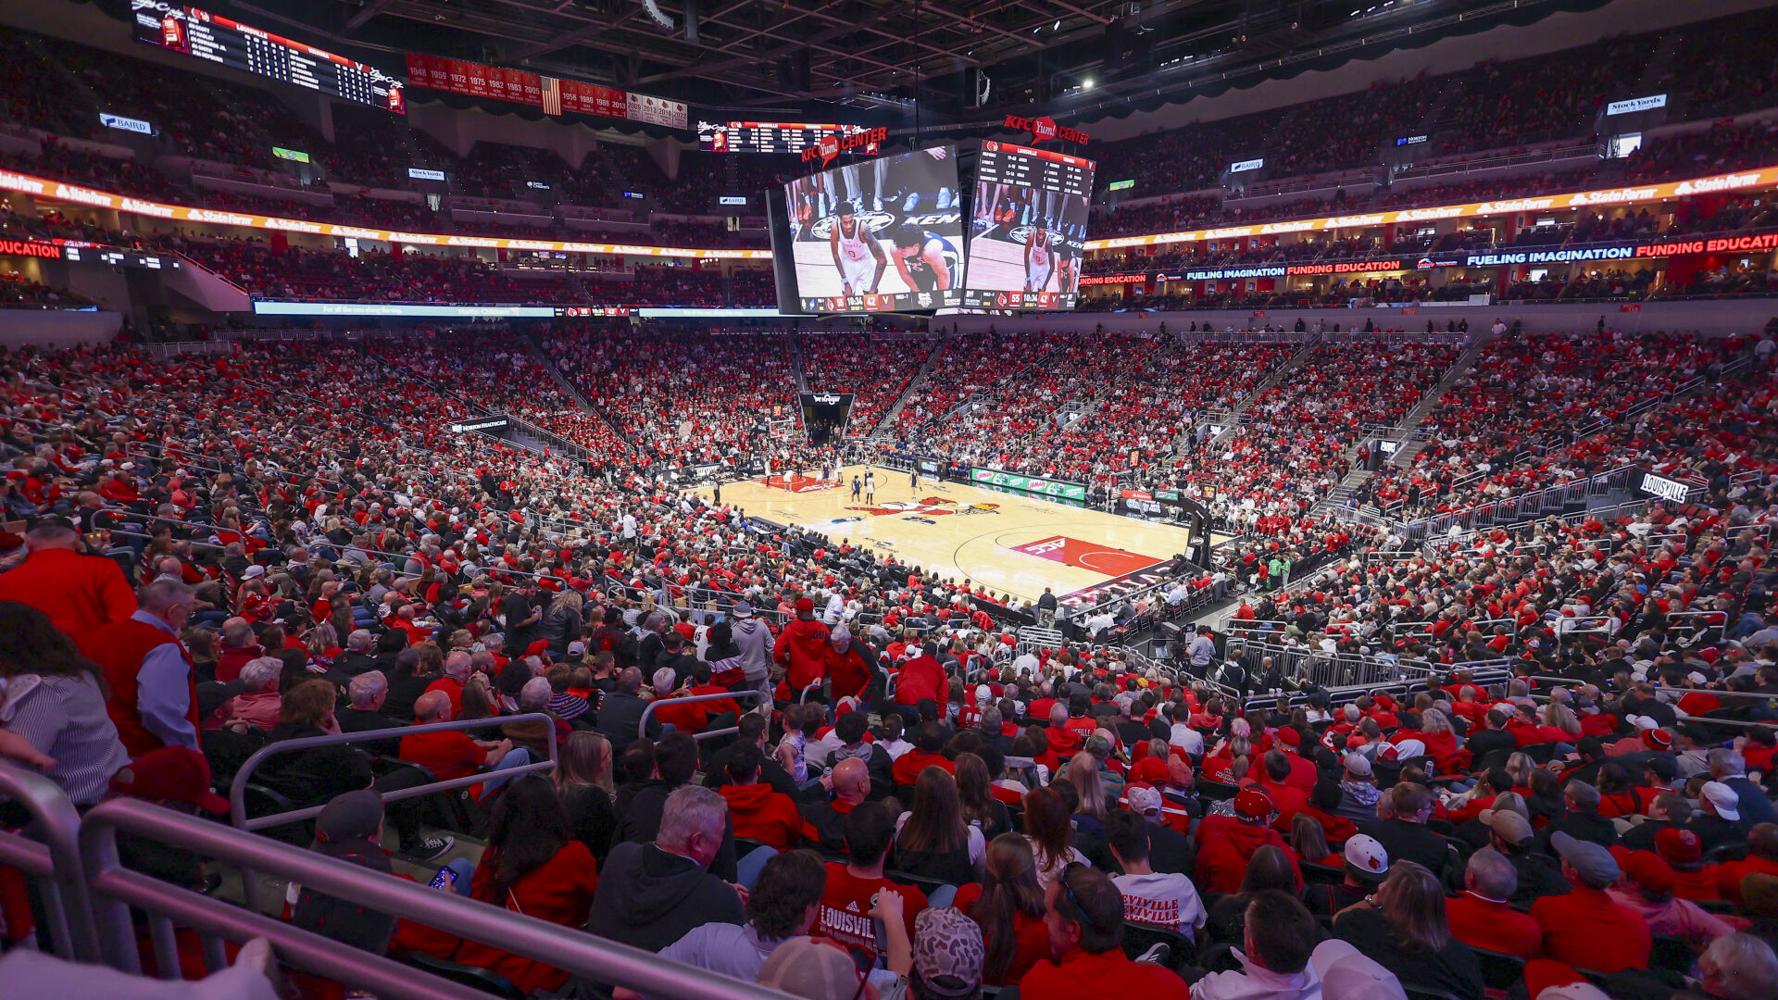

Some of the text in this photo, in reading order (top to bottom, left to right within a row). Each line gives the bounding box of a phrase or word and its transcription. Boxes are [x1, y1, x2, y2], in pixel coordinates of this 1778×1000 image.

[450, 73, 467, 83] 1972
[469, 76, 486, 86] 1975
[488, 79, 504, 89] 1982
[506, 82, 523, 92] 1983
[1612, 97, 1662, 110] Stock Yards
[117, 119, 146, 131] BAIRD
[1004, 115, 1089, 145] KFC Yum! CENTER
[801, 127, 888, 162] KFC Yum! CENTER
[0, 241, 61, 259] UCATION
[1466, 253, 1526, 266] FUELING
[1529, 247, 1633, 262] IMAGINATION
[1635, 240, 1704, 257] FUNDING
[1187, 260, 1400, 280] FUELING IMAGINATION FUNDING EDUCATION
[1105, 275, 1146, 284] EDUCATION
[1011, 294, 1020, 302] 55
[1641, 473, 1689, 504] LOUISVILLE
[1024, 537, 1066, 555] ACC
[820, 904, 876, 939] LOUISVIL
